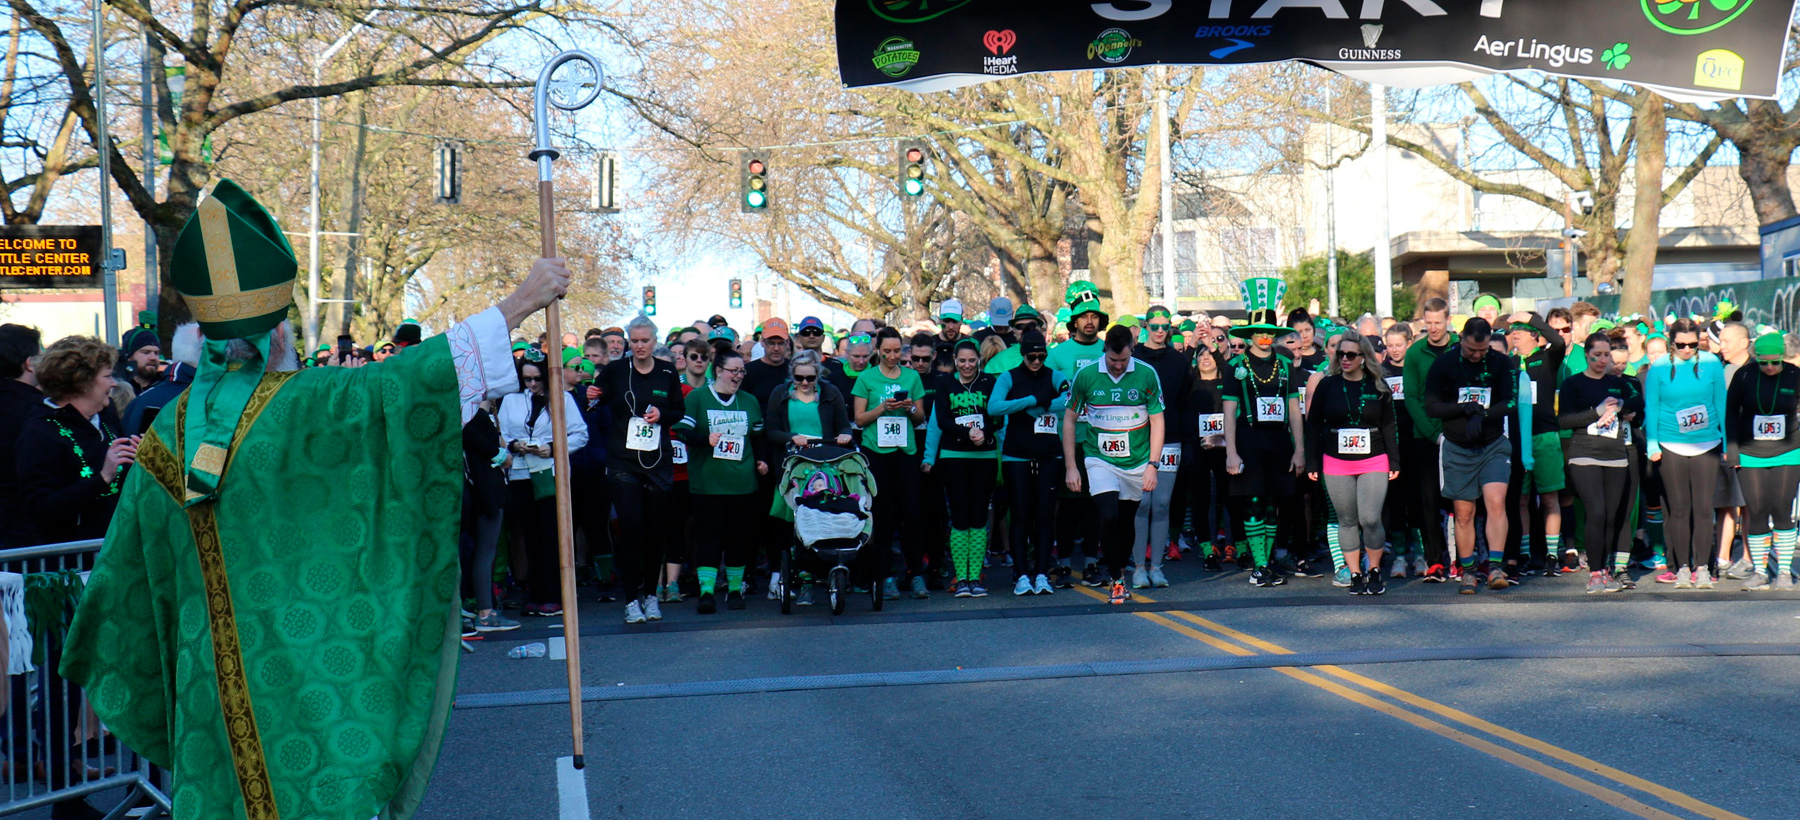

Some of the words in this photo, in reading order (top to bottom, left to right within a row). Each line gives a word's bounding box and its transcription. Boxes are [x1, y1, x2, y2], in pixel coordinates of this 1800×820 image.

[1195, 25, 1273, 38] BROOKS
[1338, 47, 1401, 60] GUINNESS
[1473, 34, 1515, 56] Aer
[1517, 38, 1593, 67] Lingus
[874, 51, 919, 68] POTATOES
[984, 55, 1017, 65] iHeart
[983, 65, 1018, 74] MEDIA
[58, 238, 77, 250] TO
[35, 252, 90, 264] CENTER
[1111, 392, 1121, 402] 12
[1262, 404, 1282, 416] 3282
[713, 414, 745, 426] Cannabis
[1106, 414, 1130, 423] Lingus
[1681, 413, 1705, 428] 3722
[635, 425, 654, 439] 165
[884, 423, 901, 435] 548
[718, 440, 740, 455] 4370
[1102, 440, 1126, 453] 4269
